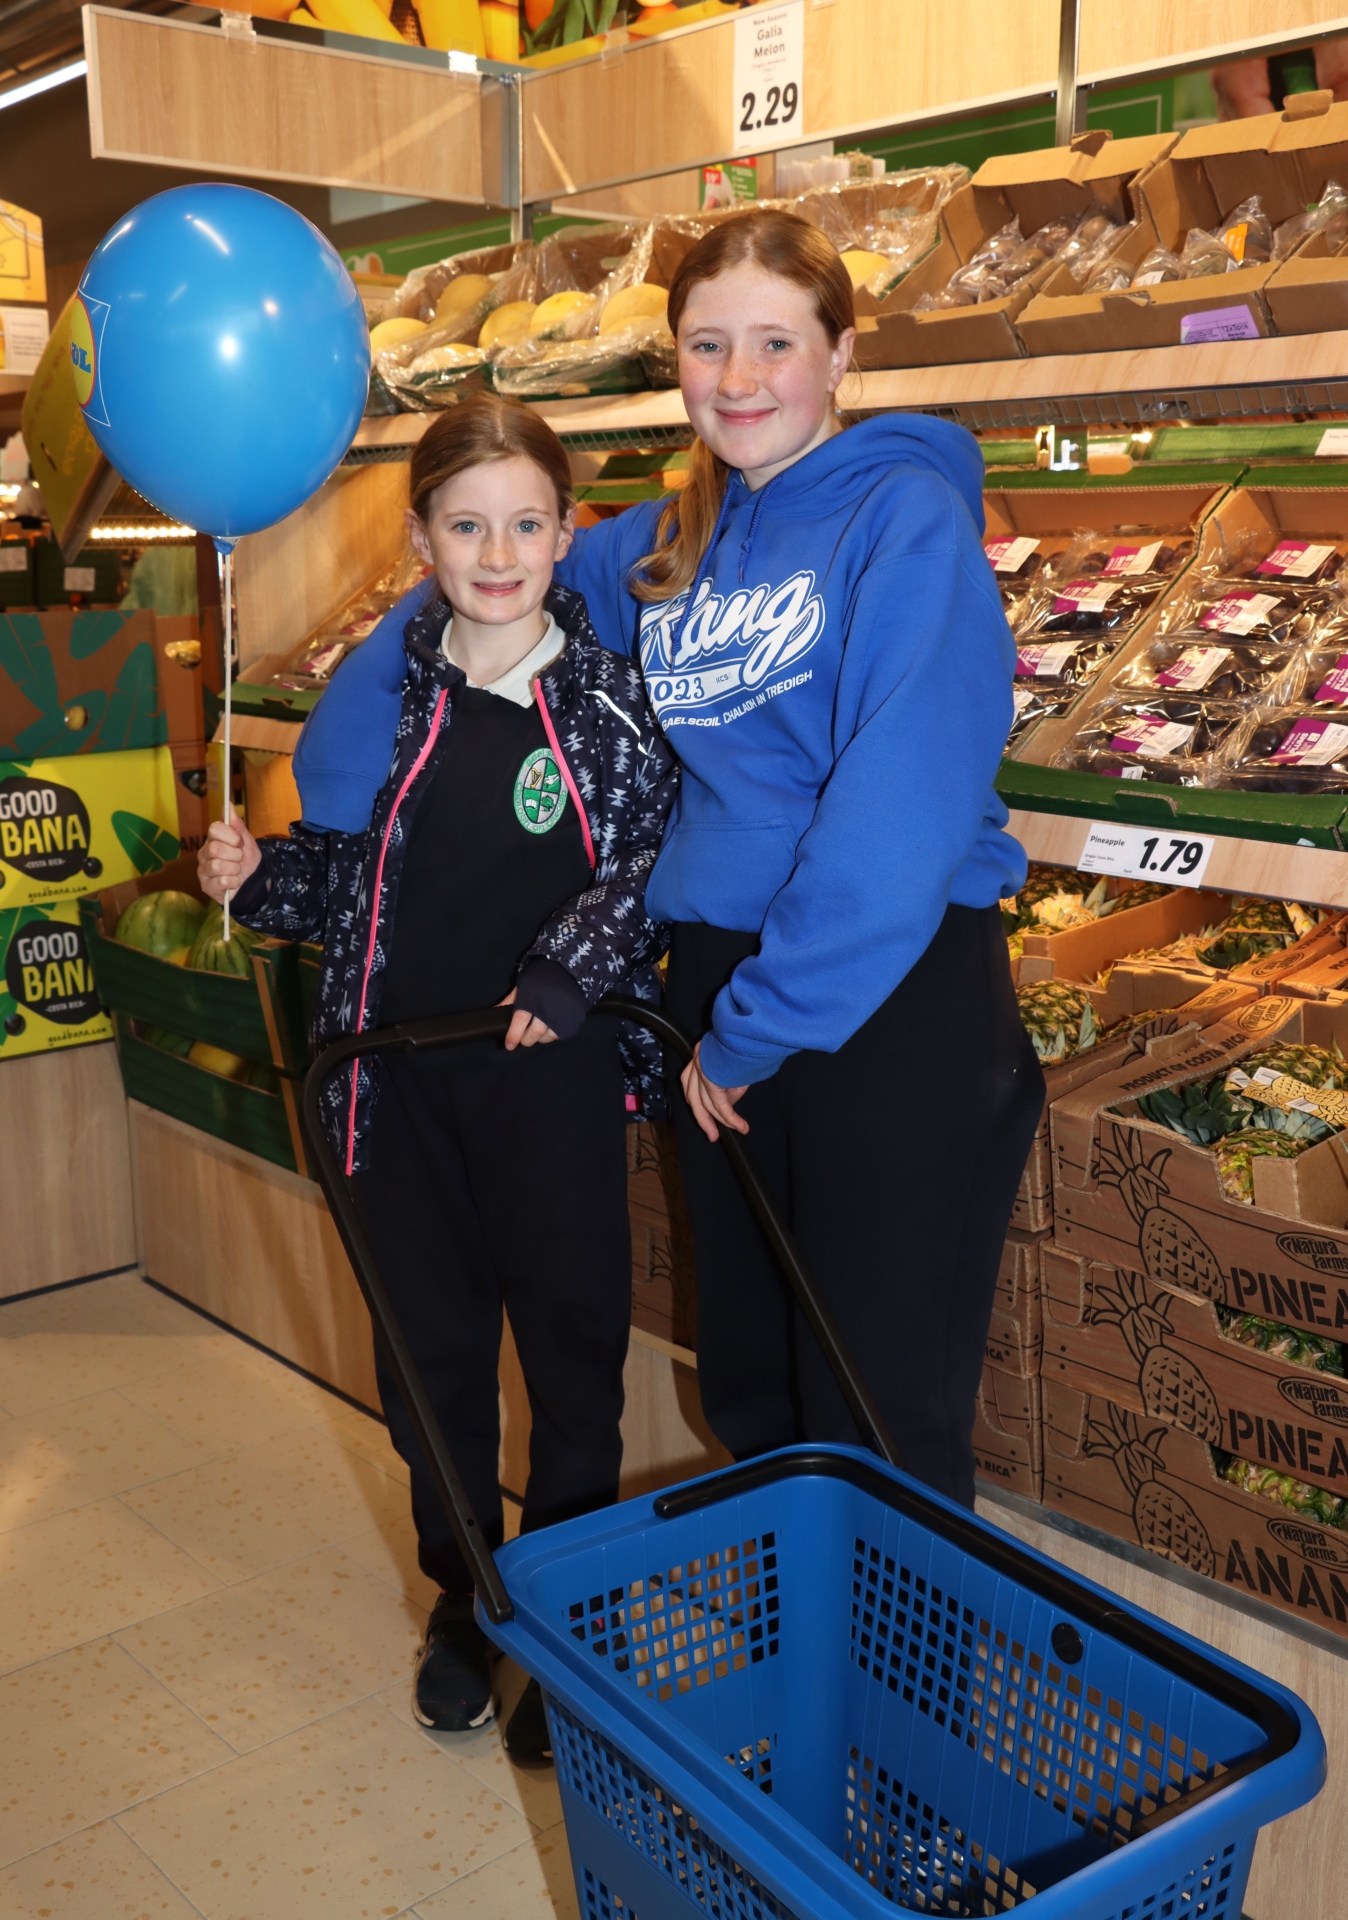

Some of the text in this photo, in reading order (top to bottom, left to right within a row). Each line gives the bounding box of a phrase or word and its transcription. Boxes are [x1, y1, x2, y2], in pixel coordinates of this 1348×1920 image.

[757, 24, 782, 41] Galia
[754, 42, 785, 59] Melon
[740, 82, 798, 131] 2.29
[716, 673, 729, 684] KCS
[645, 677, 705, 702] 023
[662, 669, 813, 732] GAELSCOIL CHALADH AN TREOIGH
[0, 788, 58, 820] GOOD
[1, 813, 87, 858] BANA
[1090, 835, 1125, 847] Pineapple
[1139, 837, 1204, 875] 1.79
[28, 886, 88, 903] goodbana.com
[18, 931, 78, 964] GOOD
[1243, 1004, 1267, 1027] Natura
[1262, 1004, 1281, 1022] Farms
[48, 1026, 107, 1046] goodbana.com
[1118, 1067, 1174, 1092] PRODUCT
[1169, 1063, 1188, 1072] OF
[1185, 1048, 1226, 1067] COSTA
[1219, 1032, 1250, 1050] RICA
[1290, 1237, 1340, 1255] Natura
[1311, 1254, 1348, 1269] Farms
[985, 1346, 1004, 1363] ICA
[1291, 1382, 1339, 1403] Natura
[1311, 1400, 1348, 1419] Farms
[984, 1460, 1011, 1478] RICA
[1280, 1524, 1327, 1547] Natura
[1300, 1542, 1338, 1562] Farms
